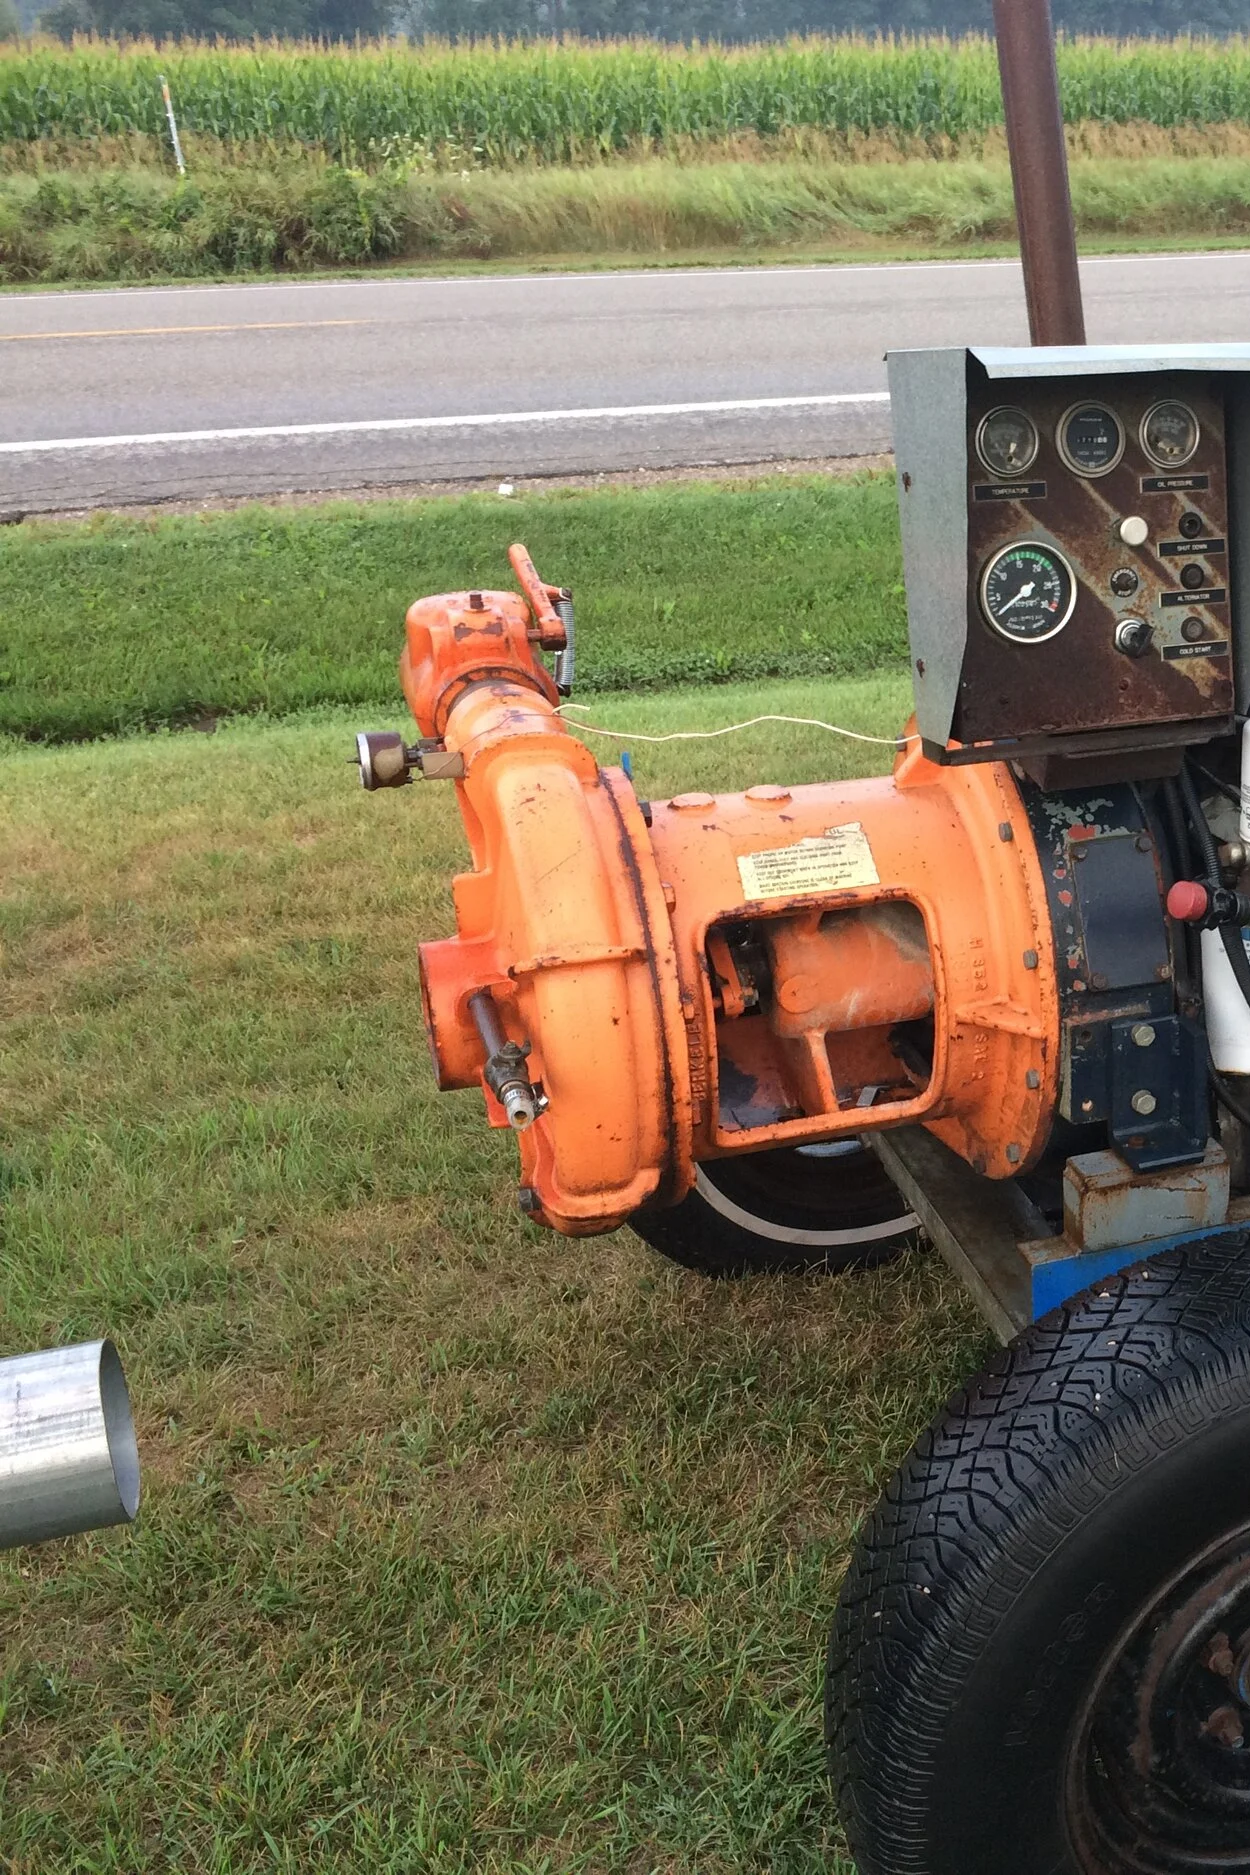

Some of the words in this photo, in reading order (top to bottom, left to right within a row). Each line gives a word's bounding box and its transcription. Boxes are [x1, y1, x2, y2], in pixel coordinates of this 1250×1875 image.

[1167, 479, 1194, 488] PRESSURE
[992, 486, 1030, 495] TEMPERATURE
[1176, 544, 1191, 552] SHUT
[1191, 543, 1208, 551] DOWN
[1177, 593, 1210, 601] ALTERNATOR
[1179, 647, 1194, 655] COLD
[1194, 646, 1211, 654] START
